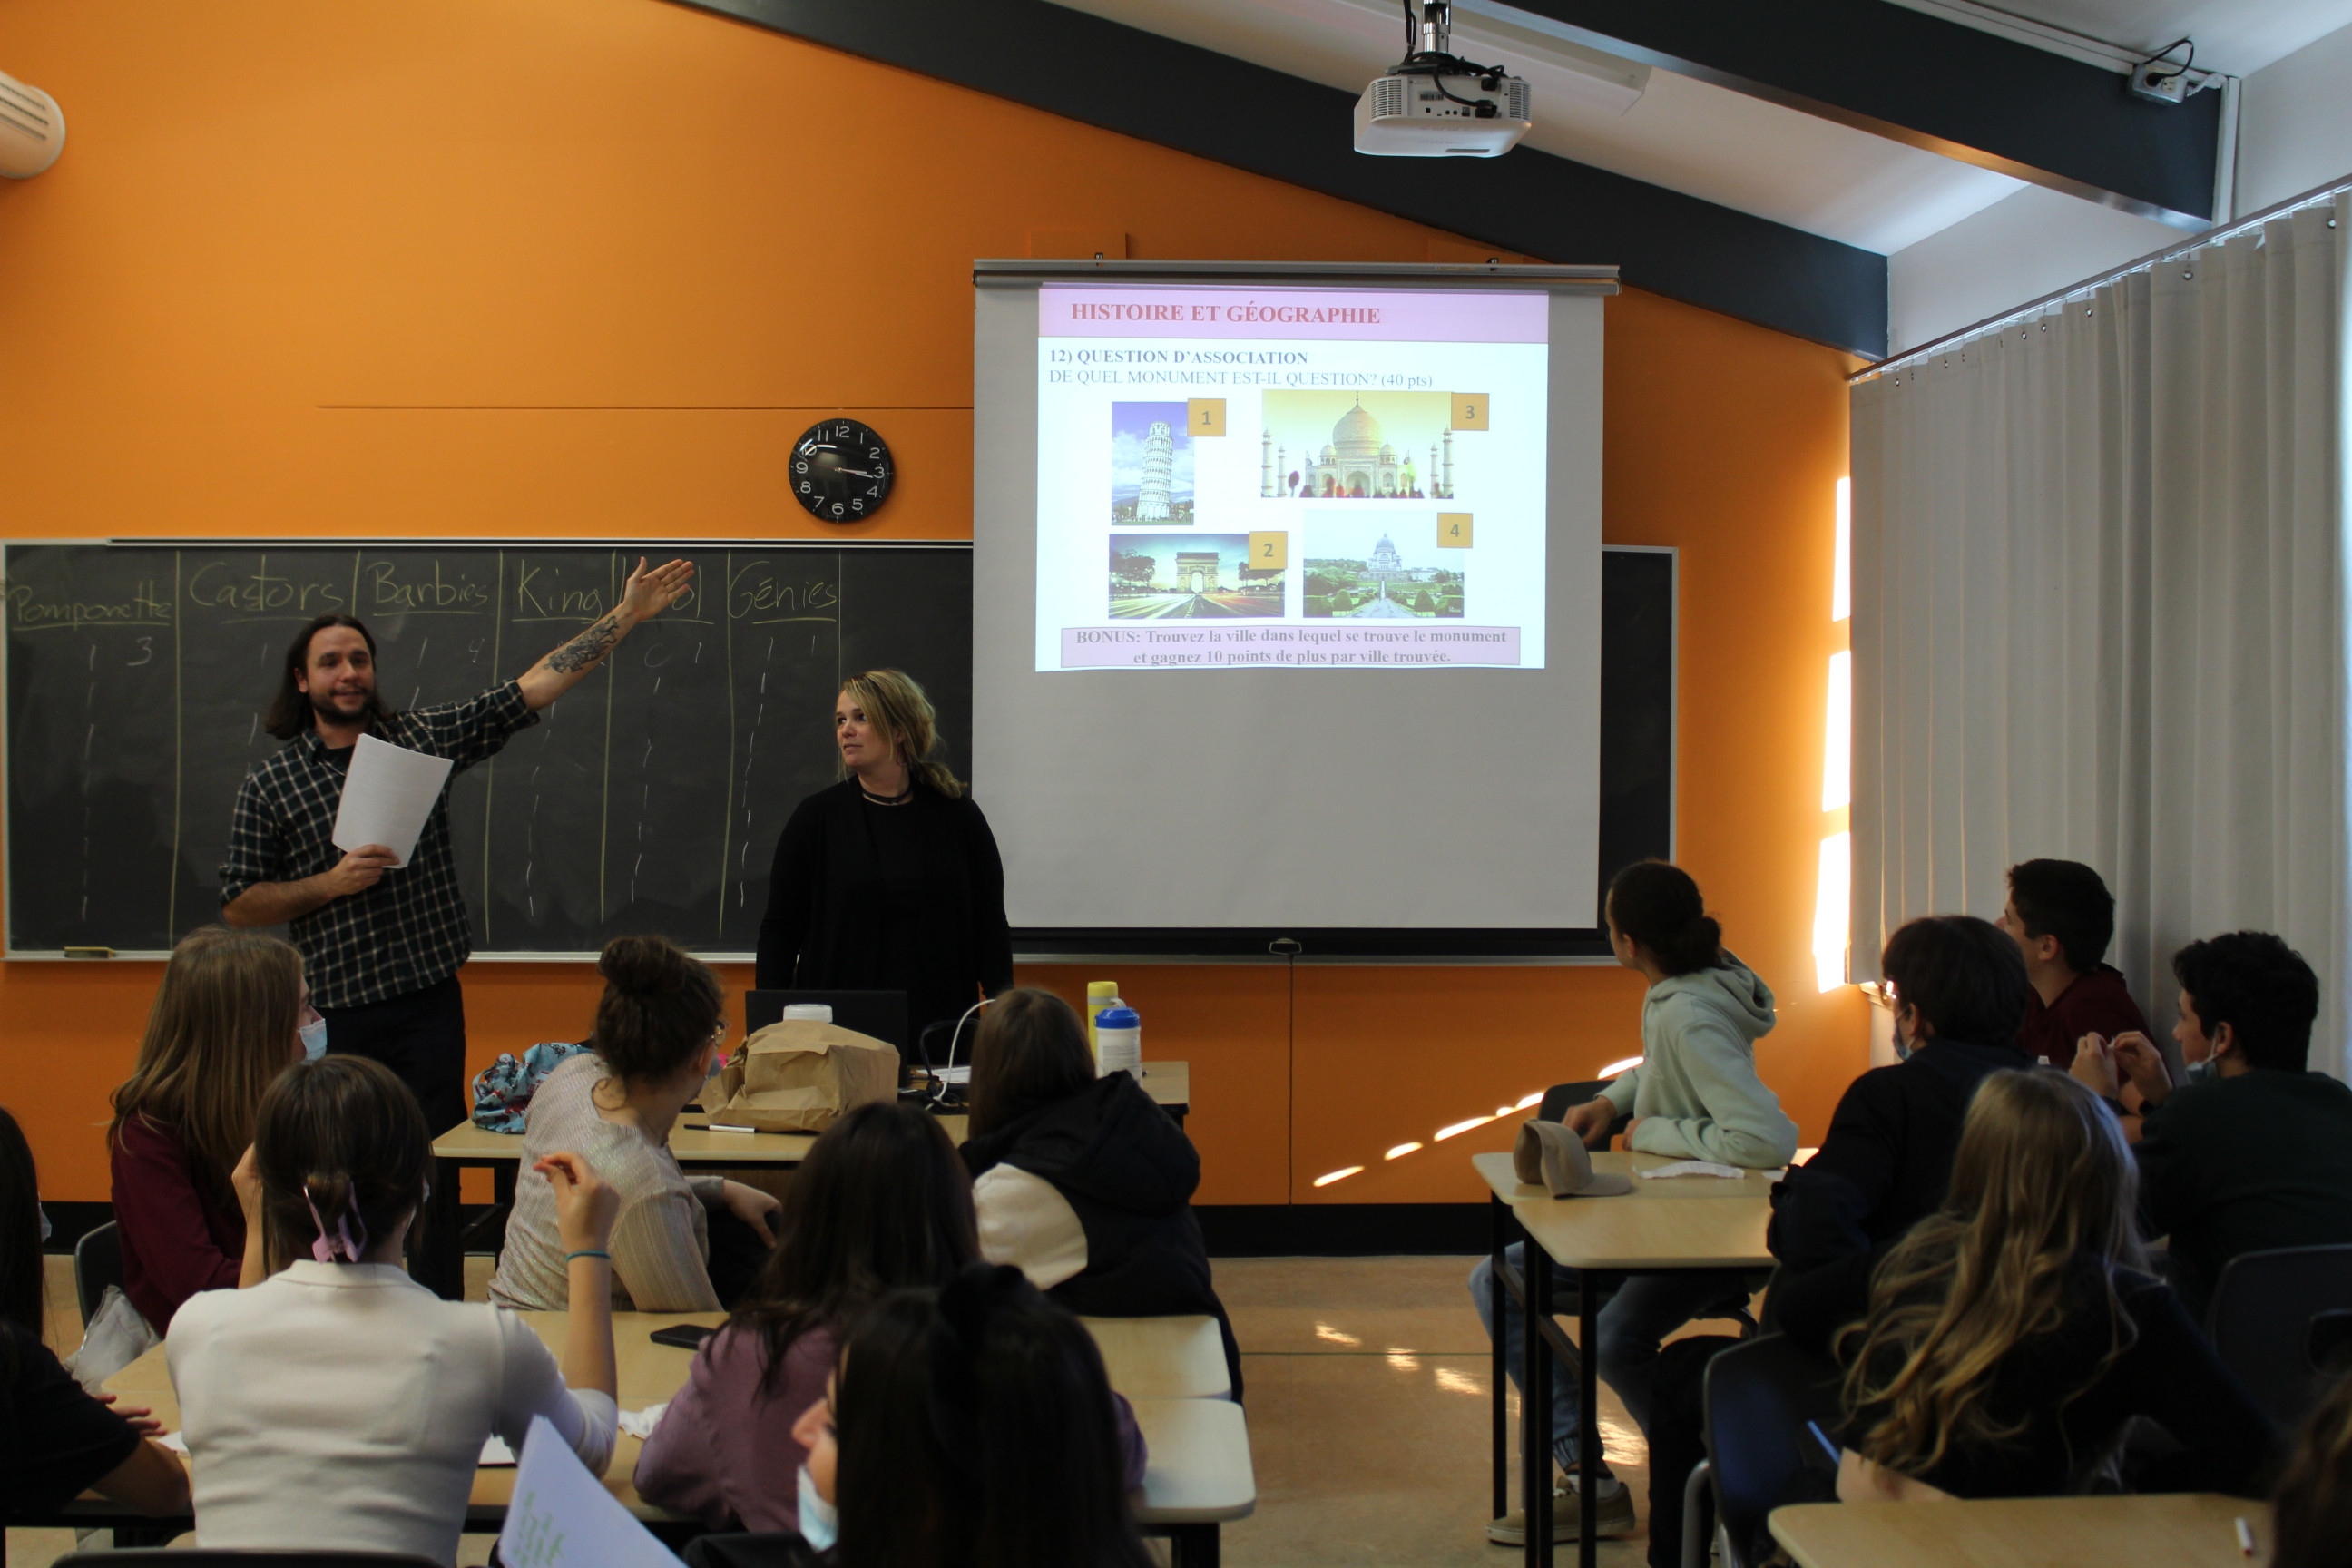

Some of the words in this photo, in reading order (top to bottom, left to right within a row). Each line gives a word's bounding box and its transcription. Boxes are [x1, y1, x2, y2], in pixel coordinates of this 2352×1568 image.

[1071, 303, 1184, 321] HISTOIRE
[1191, 305, 1220, 322] ET
[1226, 300, 1381, 324] GÉOGRAPHIE
[1050, 349, 1073, 365] 12)
[1077, 349, 1168, 365] QUESTION
[1049, 369, 1073, 383] DE
[1077, 370, 1122, 386] QUEL
[1127, 370, 1228, 385] MONUMENT
[1232, 371, 1282, 386] EST-IL
[1286, 372, 1377, 387] QUESTION?
[1380, 373, 1404, 387] (40
[1407, 374, 1433, 390] pts)
[1201, 410, 1211, 426] 1
[1464, 405, 1475, 419] 3
[818, 429, 828, 442] 11
[835, 425, 850, 438] 12
[869, 447, 880, 459] 2
[796, 461, 808, 474] 9
[873, 466, 885, 479] 3
[800, 481, 811, 494] 8
[866, 485, 877, 498] 4
[813, 495, 825, 508] 7
[831, 503, 844, 514] 6
[851, 498, 863, 511] 5
[1449, 524, 1460, 538] 4
[1263, 543, 1274, 558] 2
[189, 554, 346, 612] Castors
[728, 560, 837, 619] Génies
[1076, 630, 1141, 644] BONUS:
[1146, 630, 1205, 643] Trouvez
[1209, 630, 1222, 642] la
[1226, 629, 1258, 642] ville
[1260, 629, 1294, 642] dans
[1298, 629, 1341, 645] lequel
[1345, 632, 1359, 642] se
[1363, 631, 1410, 642] trouve
[1414, 630, 1426, 642] le
[1430, 631, 1507, 642] monument
[127, 635, 152, 666] 3
[1133, 652, 1147, 663] et
[1151, 654, 1201, 666] gagnez
[1207, 651, 1222, 663] 10
[1227, 650, 1271, 665] points
[1276, 649, 1293, 662] de
[1297, 650, 1327, 665] plus
[1330, 652, 1356, 665] par
[1359, 650, 1389, 662] ville
[1393, 650, 1451, 663] trouvée.
